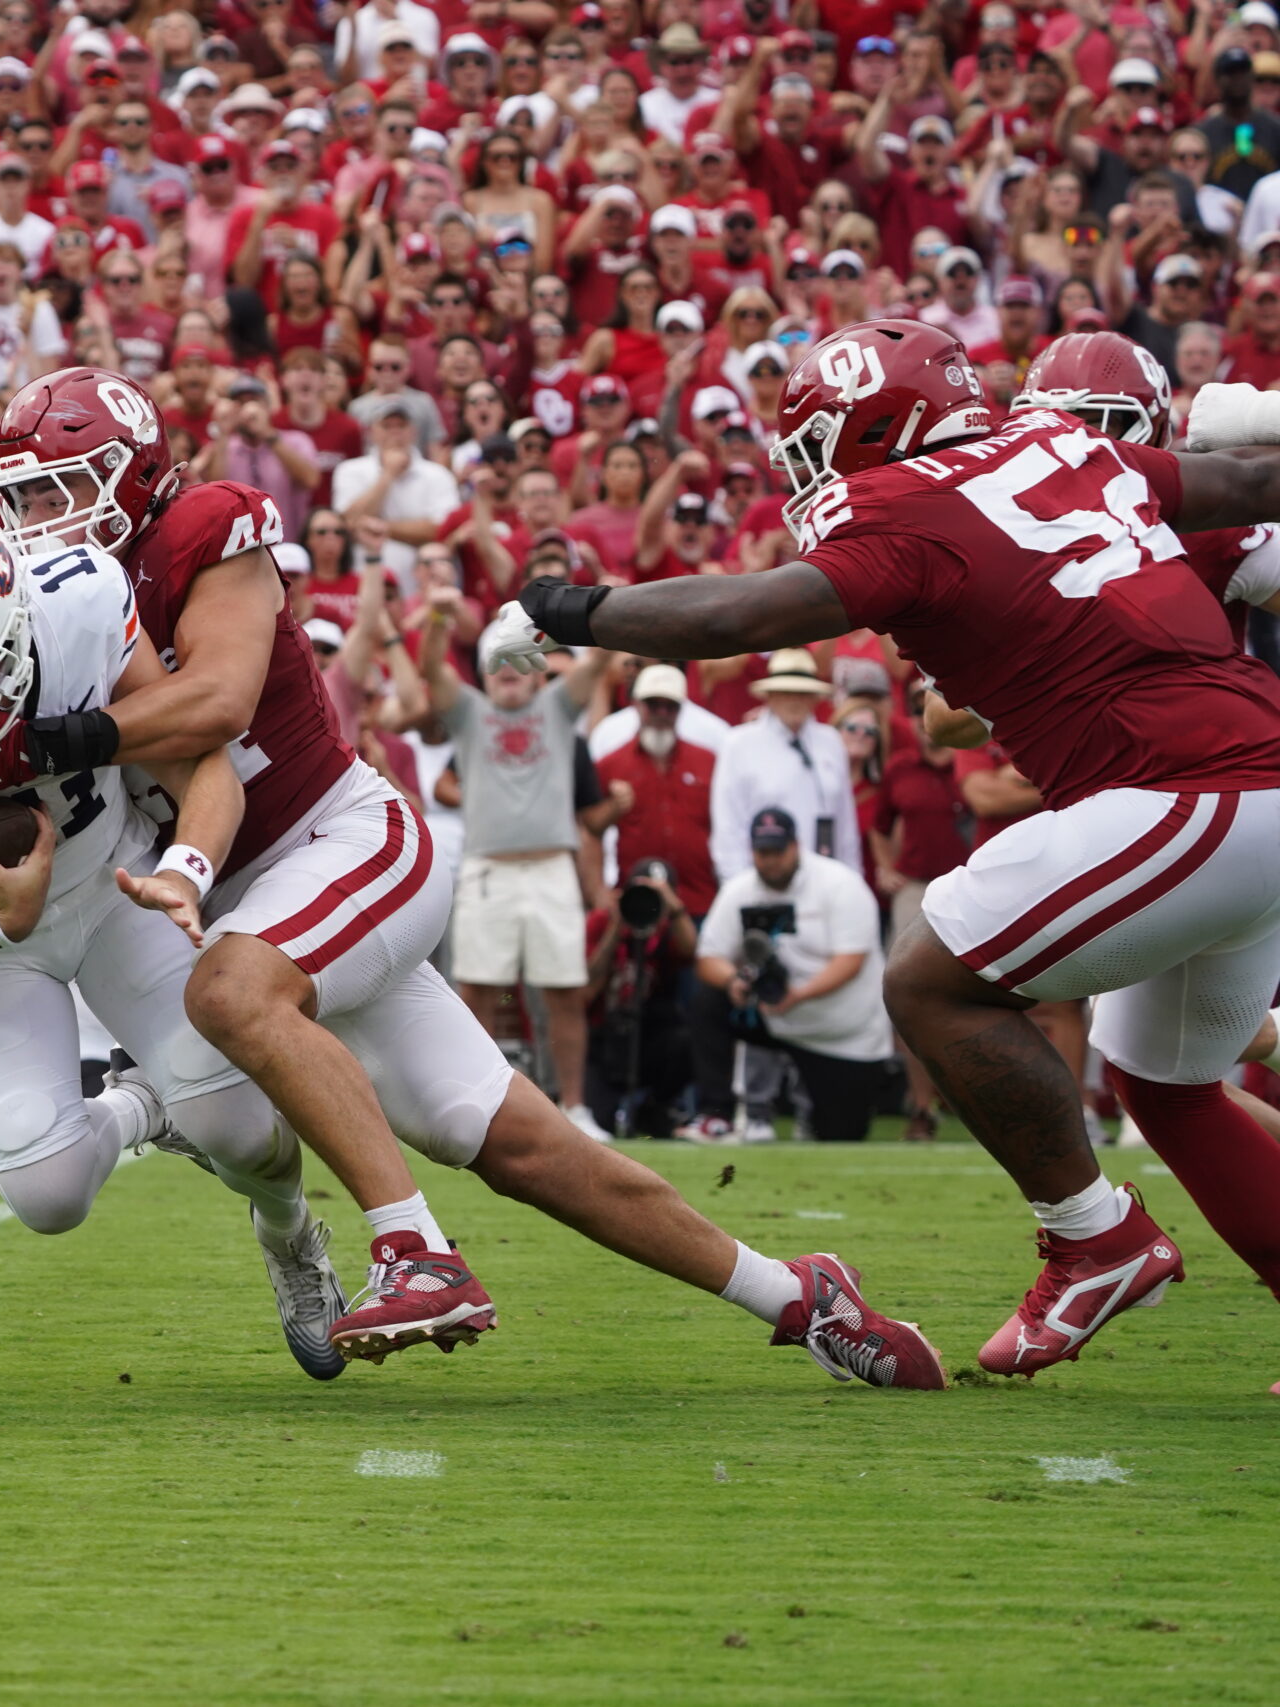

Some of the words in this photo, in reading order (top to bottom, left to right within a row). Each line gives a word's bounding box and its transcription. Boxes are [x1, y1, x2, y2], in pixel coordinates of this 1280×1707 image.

[819, 341, 886, 399] OU
[97, 381, 159, 444] OU
[901, 455, 966, 481] D.
[949, 409, 1073, 460] WILLIA
[221, 497, 284, 560] 44
[955, 426, 1188, 599] 52
[30, 547, 99, 594] 11
[381, 1244, 397, 1262] OU
[1152, 1245, 1172, 1260] OU
